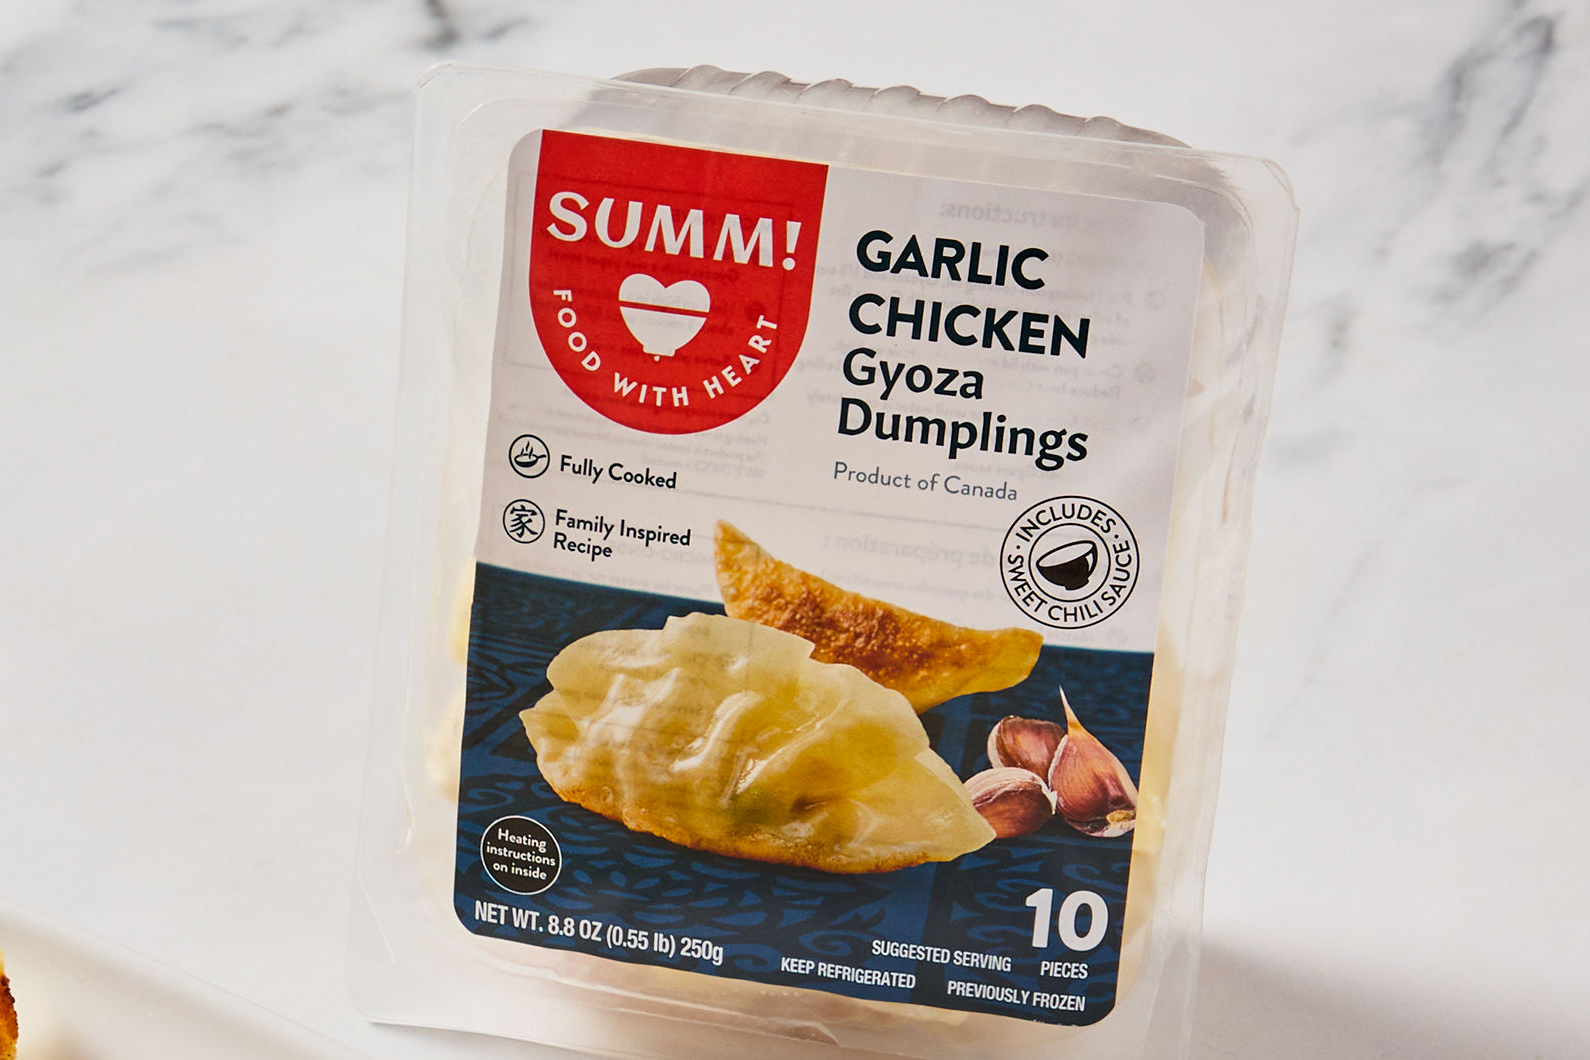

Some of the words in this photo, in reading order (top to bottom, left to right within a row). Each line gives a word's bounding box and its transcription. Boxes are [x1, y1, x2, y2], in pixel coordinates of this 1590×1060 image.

[547, 191, 801, 271] SUMM!
[856, 230, 1049, 290] GARLIC
[848, 293, 1090, 359] CHICKEN
[553, 289, 602, 372] FOOD
[613, 372, 689, 407] WITH
[702, 315, 778, 399] HEART
[842, 347, 985, 401] Gyoza
[837, 396, 1089, 472] Dumplings
[560, 454, 604, 484] Fully
[608, 462, 677, 489] Cooked
[833, 461, 911, 489] Product
[917, 474, 938, 492] of
[944, 475, 1018, 501] Canada
[509, 504, 539, 538] 家
[555, 508, 615, 540] Family
[619, 519, 692, 547] Inspired
[1015, 503, 1116, 543] INCLUDES
[553, 532, 613, 562] Recipe
[1007, 553, 1048, 613] SWEET
[1047, 600, 1104, 622] CHILI
[1101, 540, 1132, 606] SAUCE
[486, 842, 556, 867] instructions
[497, 827, 547, 853] Heating
[493, 861, 508, 873] on
[511, 864, 547, 881] inside
[474, 900, 509, 926] NET
[512, 907, 543, 932] WT.
[547, 915, 575, 937] 8.8
[579, 919, 602, 942] OZ
[606, 924, 648, 950] (0.55
[653, 931, 676, 958] lb)
[680, 936, 724, 966] 250g
[1025, 888, 1109, 951] 10
[781, 957, 815, 976] KEEP
[818, 962, 916, 989] REFRIGERATED
[872, 940, 950, 964] SUGGESTED
[953, 950, 1012, 972] SERVING
[1040, 960, 1089, 980] PIECES
[947, 980, 1030, 1005] PREVIOUSLY
[1032, 992, 1086, 1012] FROZEN
